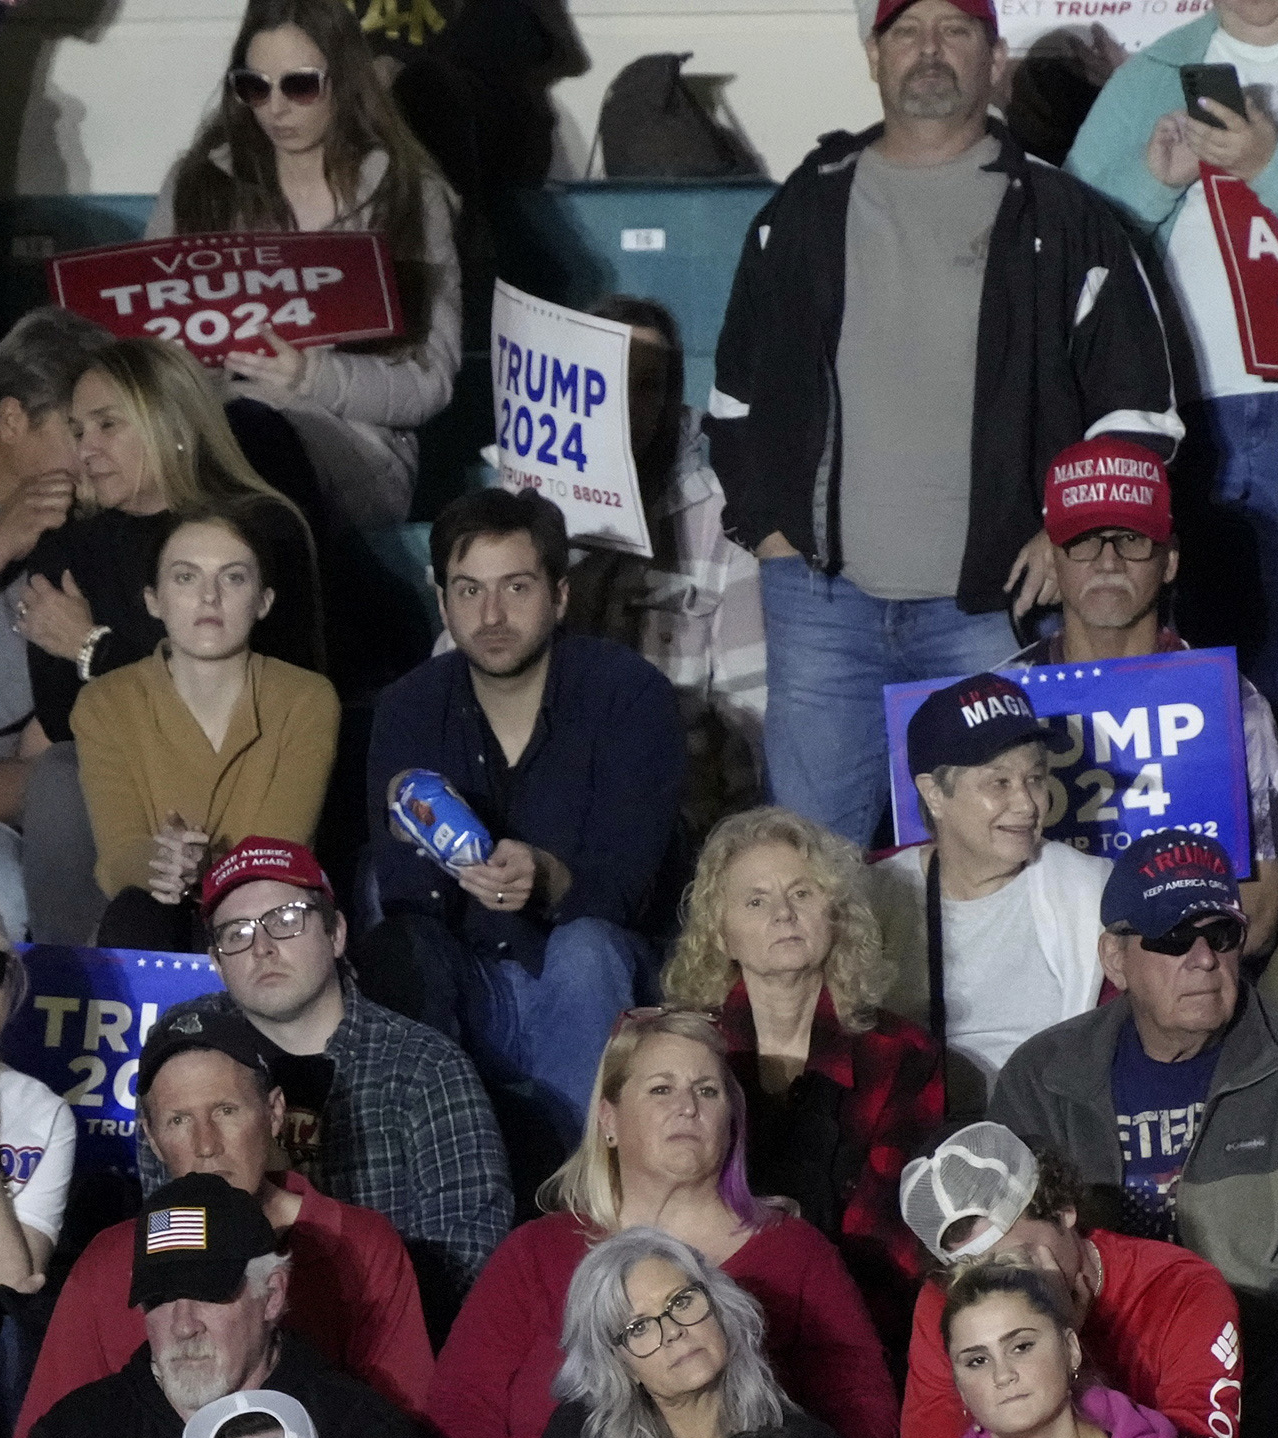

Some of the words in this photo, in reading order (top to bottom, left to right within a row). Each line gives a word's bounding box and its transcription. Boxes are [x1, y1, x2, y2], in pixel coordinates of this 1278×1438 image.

[153, 244, 282, 274] VOTE
[100, 265, 345, 316] TRUMP
[143, 297, 318, 346] 2024
[497, 335, 608, 418] TRUMP
[497, 405, 588, 473] 2024
[1054, 459, 1095, 485] MAKE
[1096, 457, 1161, 483] AMERICA
[546, 478, 568, 499] TO
[572, 483, 623, 509] 88022
[1061, 483, 1108, 508] GREAT
[1108, 483, 1153, 506] AGAIN
[240, 847, 294, 859] AMERICA
[1100, 831, 1132, 852] TO
[251, 857, 291, 869] AGAIN
[1139, 843, 1227, 878] TRUMP
[1143, 884, 1165, 899] KEEP
[1165, 879, 1206, 891] AMERICA
